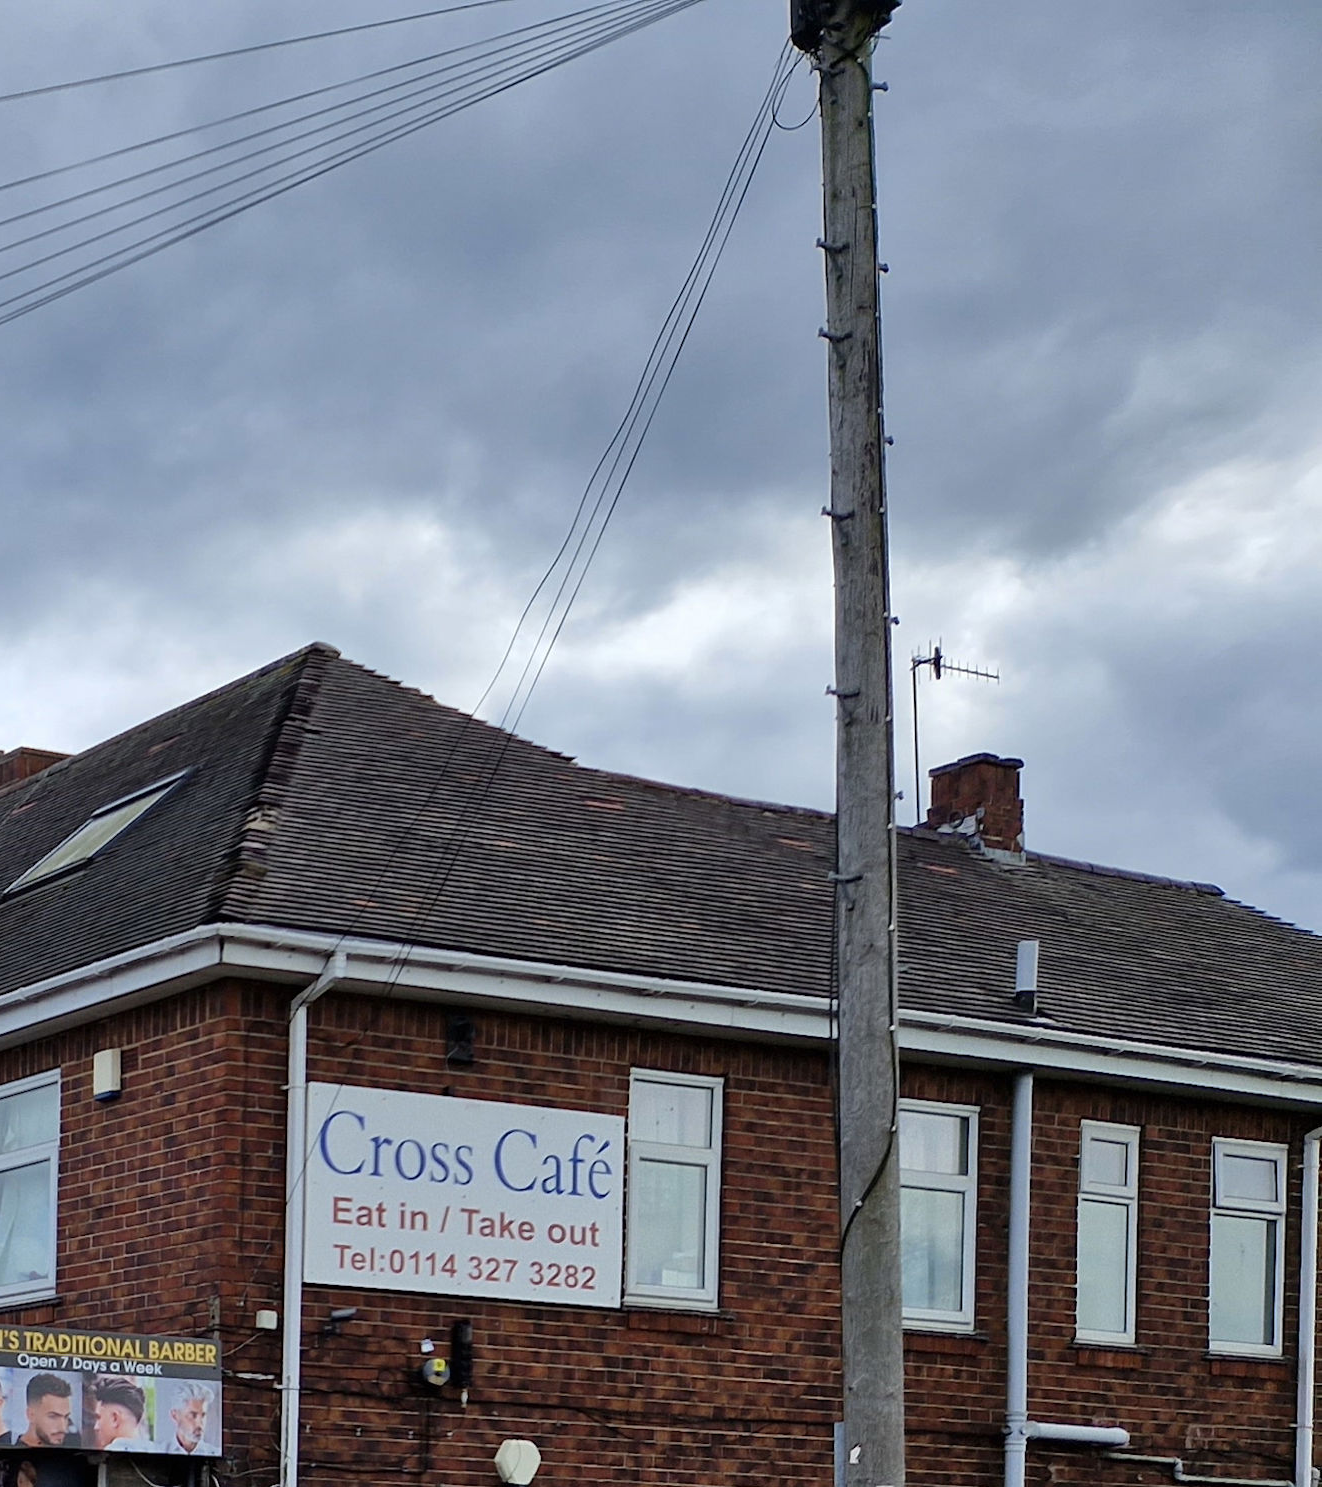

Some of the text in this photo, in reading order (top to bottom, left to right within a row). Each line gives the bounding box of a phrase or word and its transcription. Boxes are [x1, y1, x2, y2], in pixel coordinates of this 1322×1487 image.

[319, 1110, 613, 1200] Cross Café
[332, 1197, 600, 1247] Eat in / Take out
[333, 1245, 597, 1290] Tel:0114 327 3282
[17, 1353, 163, 1375] Open 7 Days a Week
[23, 1331, 144, 1359] TRADITIONAL
[149, 1340, 217, 1363] BARBER
